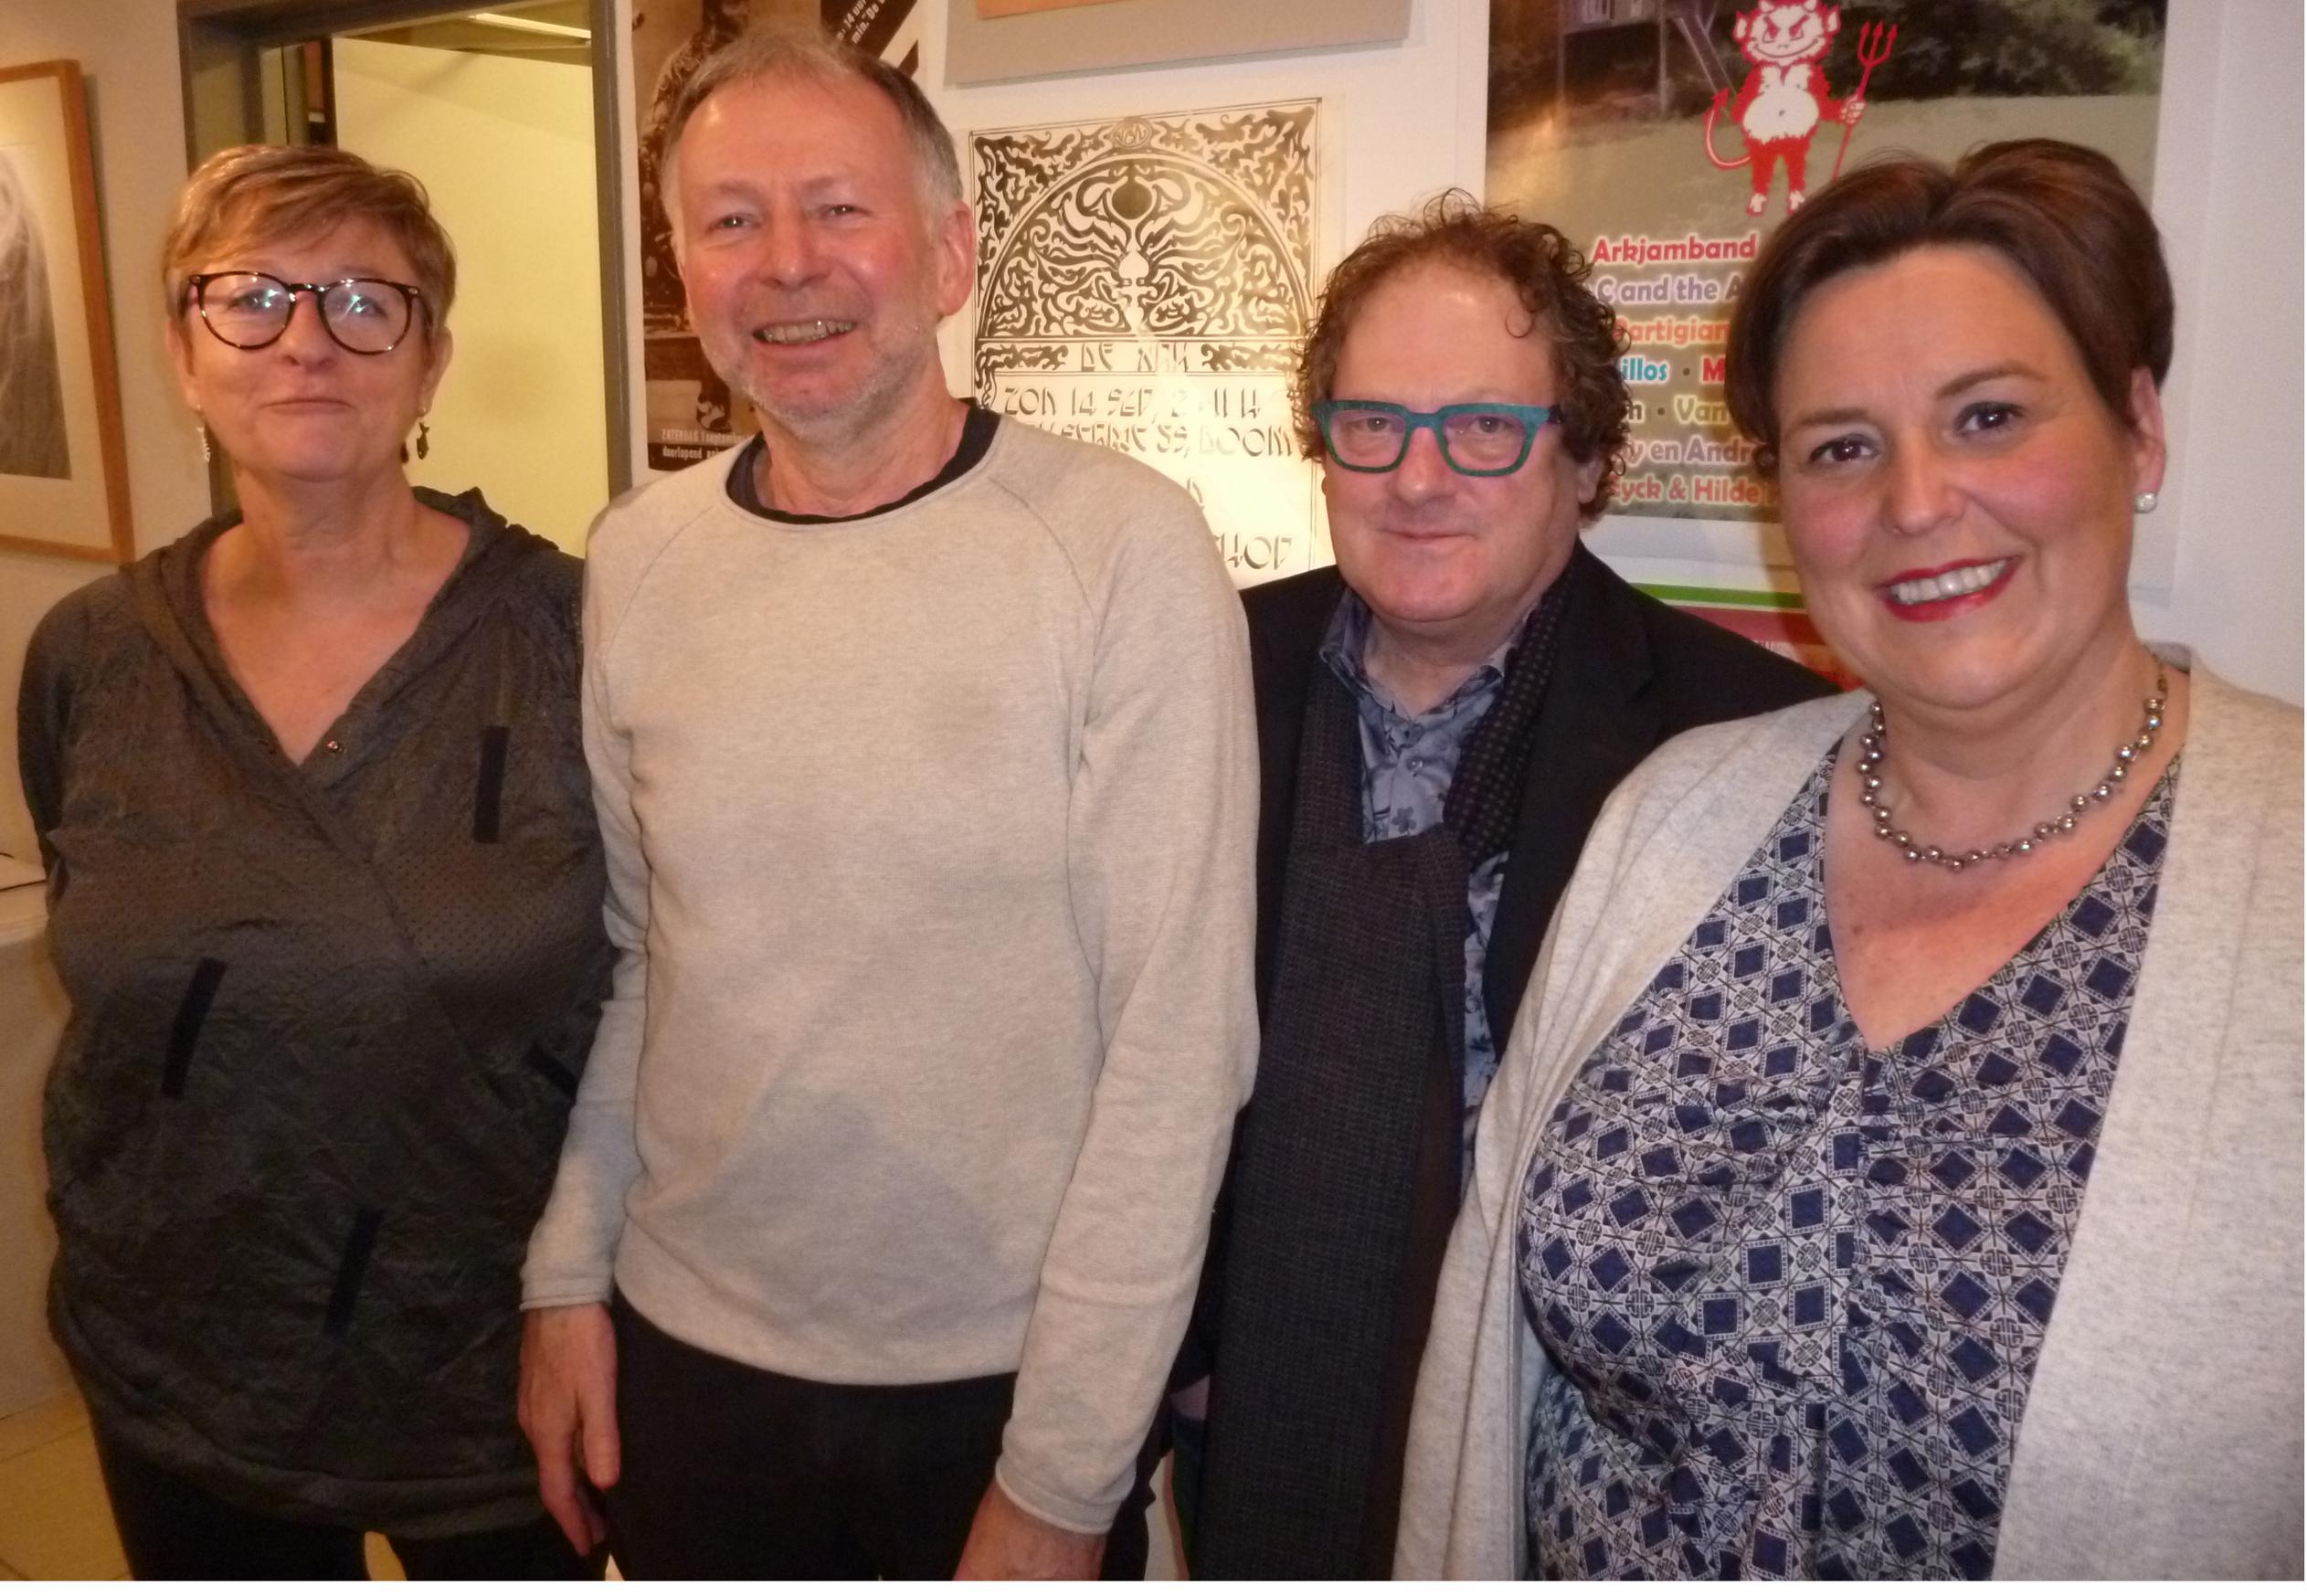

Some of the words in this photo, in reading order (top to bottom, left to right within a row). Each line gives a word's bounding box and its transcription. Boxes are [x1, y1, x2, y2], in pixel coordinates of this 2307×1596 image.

[1593, 234, 1757, 264] Arkjamband
[1621, 277, 1669, 301] and
[1677, 277, 1719, 301] the
[1650, 446, 1680, 463] en
[1668, 477, 1687, 501] &
[1694, 478, 1760, 503] Hilde
